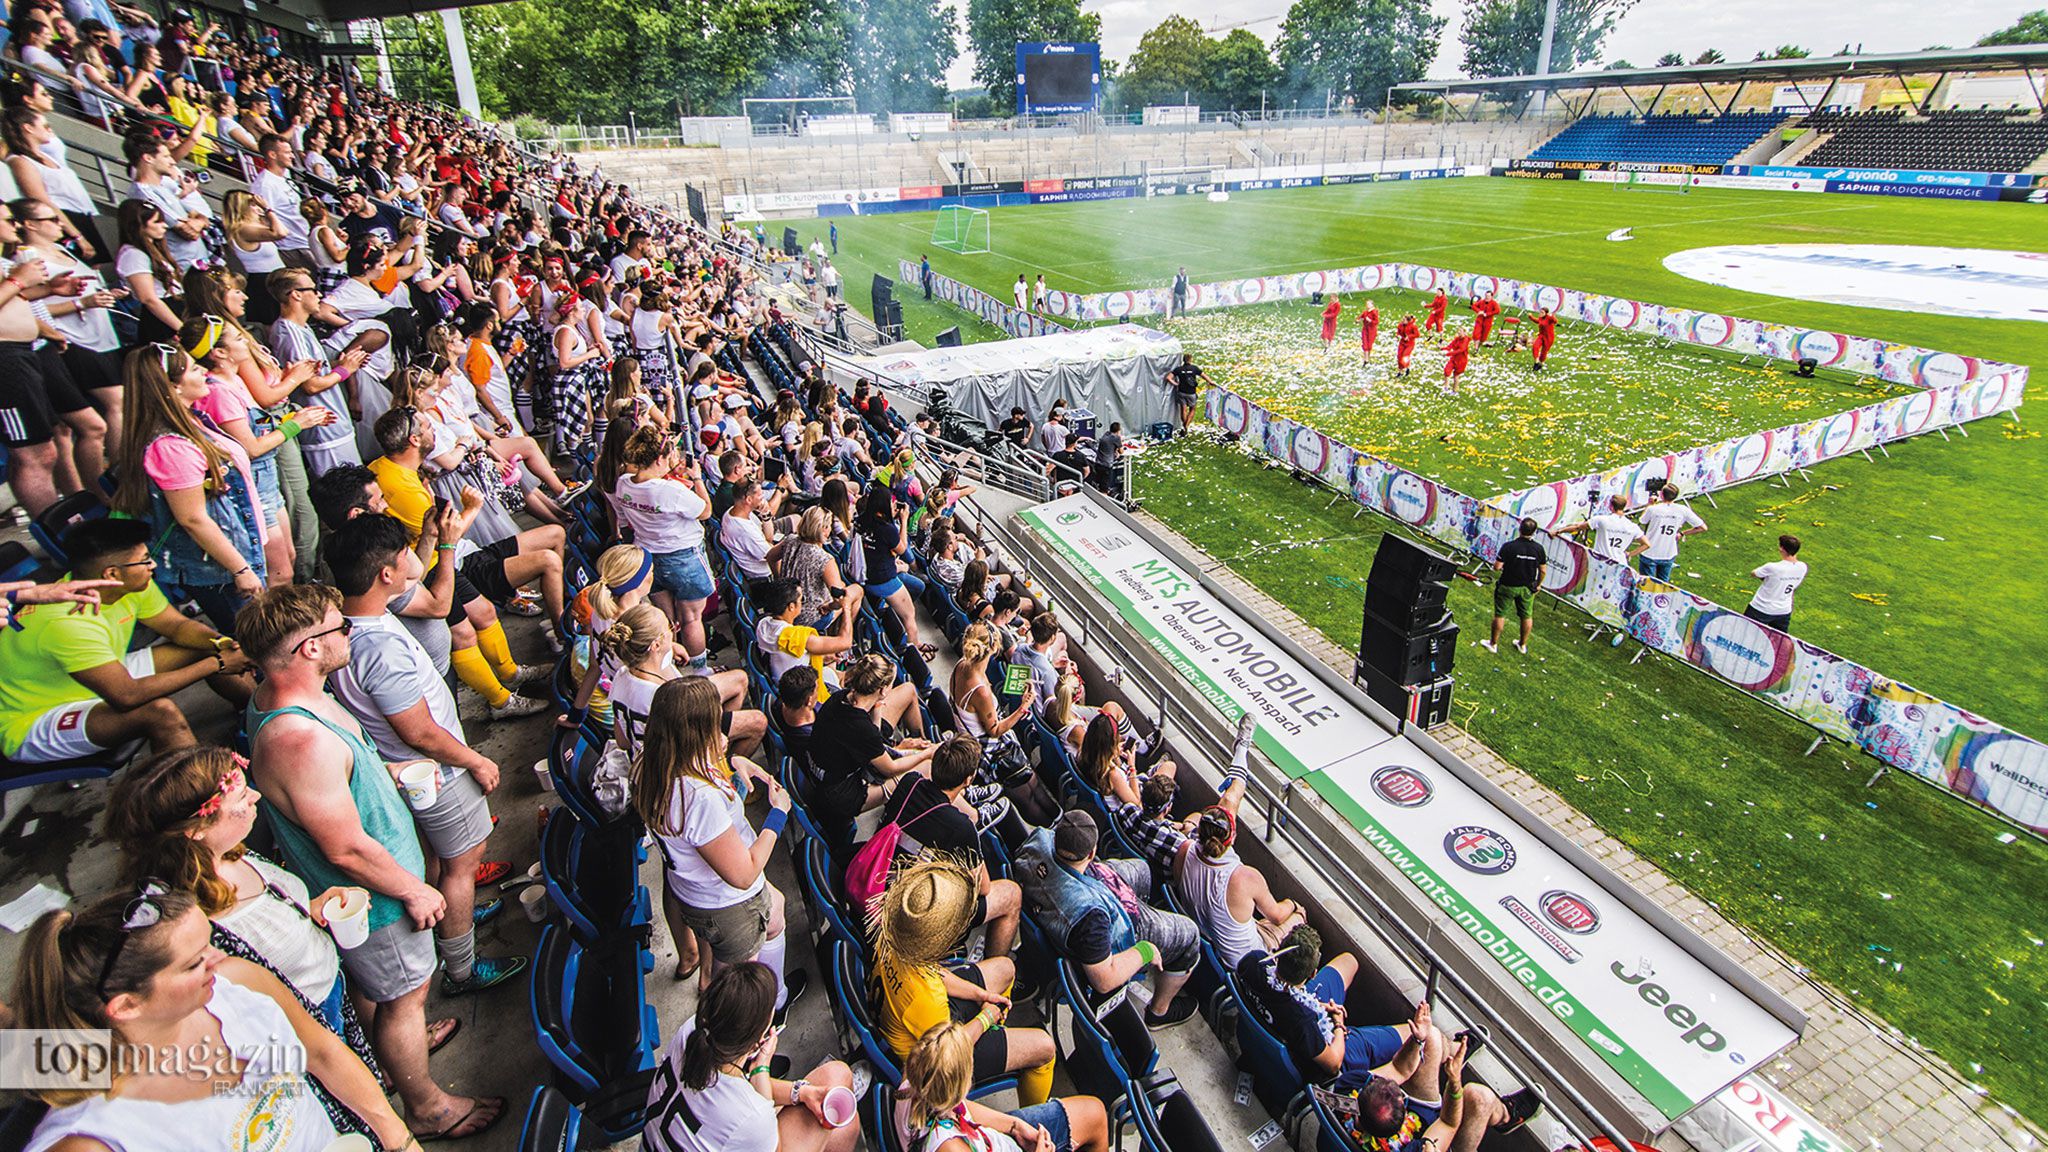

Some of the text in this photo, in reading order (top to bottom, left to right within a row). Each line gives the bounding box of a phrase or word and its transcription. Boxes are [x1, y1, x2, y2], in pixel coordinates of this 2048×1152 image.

[1520, 160, 1555, 169] DRUCKEREI
[1617, 162, 1659, 172] DRUCKEREI
[1764, 169, 1812, 178] Social Trading
[1846, 170, 1899, 183] ayondo
[1916, 174, 1971, 186] CFD-Trading
[1073, 180, 1094, 189] PRIME
[1112, 178, 1136, 187] fitness
[1838, 183, 1982, 198] SAPHIR RADIOCHIRURGIE
[1039, 193, 1068, 202] SAPHIR
[1660, 524, 1674, 536] 15
[1079, 537, 1108, 559] SEAT
[1608, 537, 1623, 549] 12
[1132, 559, 1340, 727] MTS AUTOMOBILE
[1115, 569, 1301, 736] Friedberg Oberursel Neu-Anspach
[1149, 636, 1241, 727] www.mts-mobile.
[1384, 773, 1424, 801] FIAT
[1457, 826, 1491, 837] ALFA
[1496, 835, 1515, 872] ROMEO
[1361, 824, 1575, 1019] www.mts-mobile.de
[1552, 899, 1591, 929] FIAT
[1509, 901, 1574, 959] PROFESSIONAL
[1610, 960, 1727, 1053] Jeep
